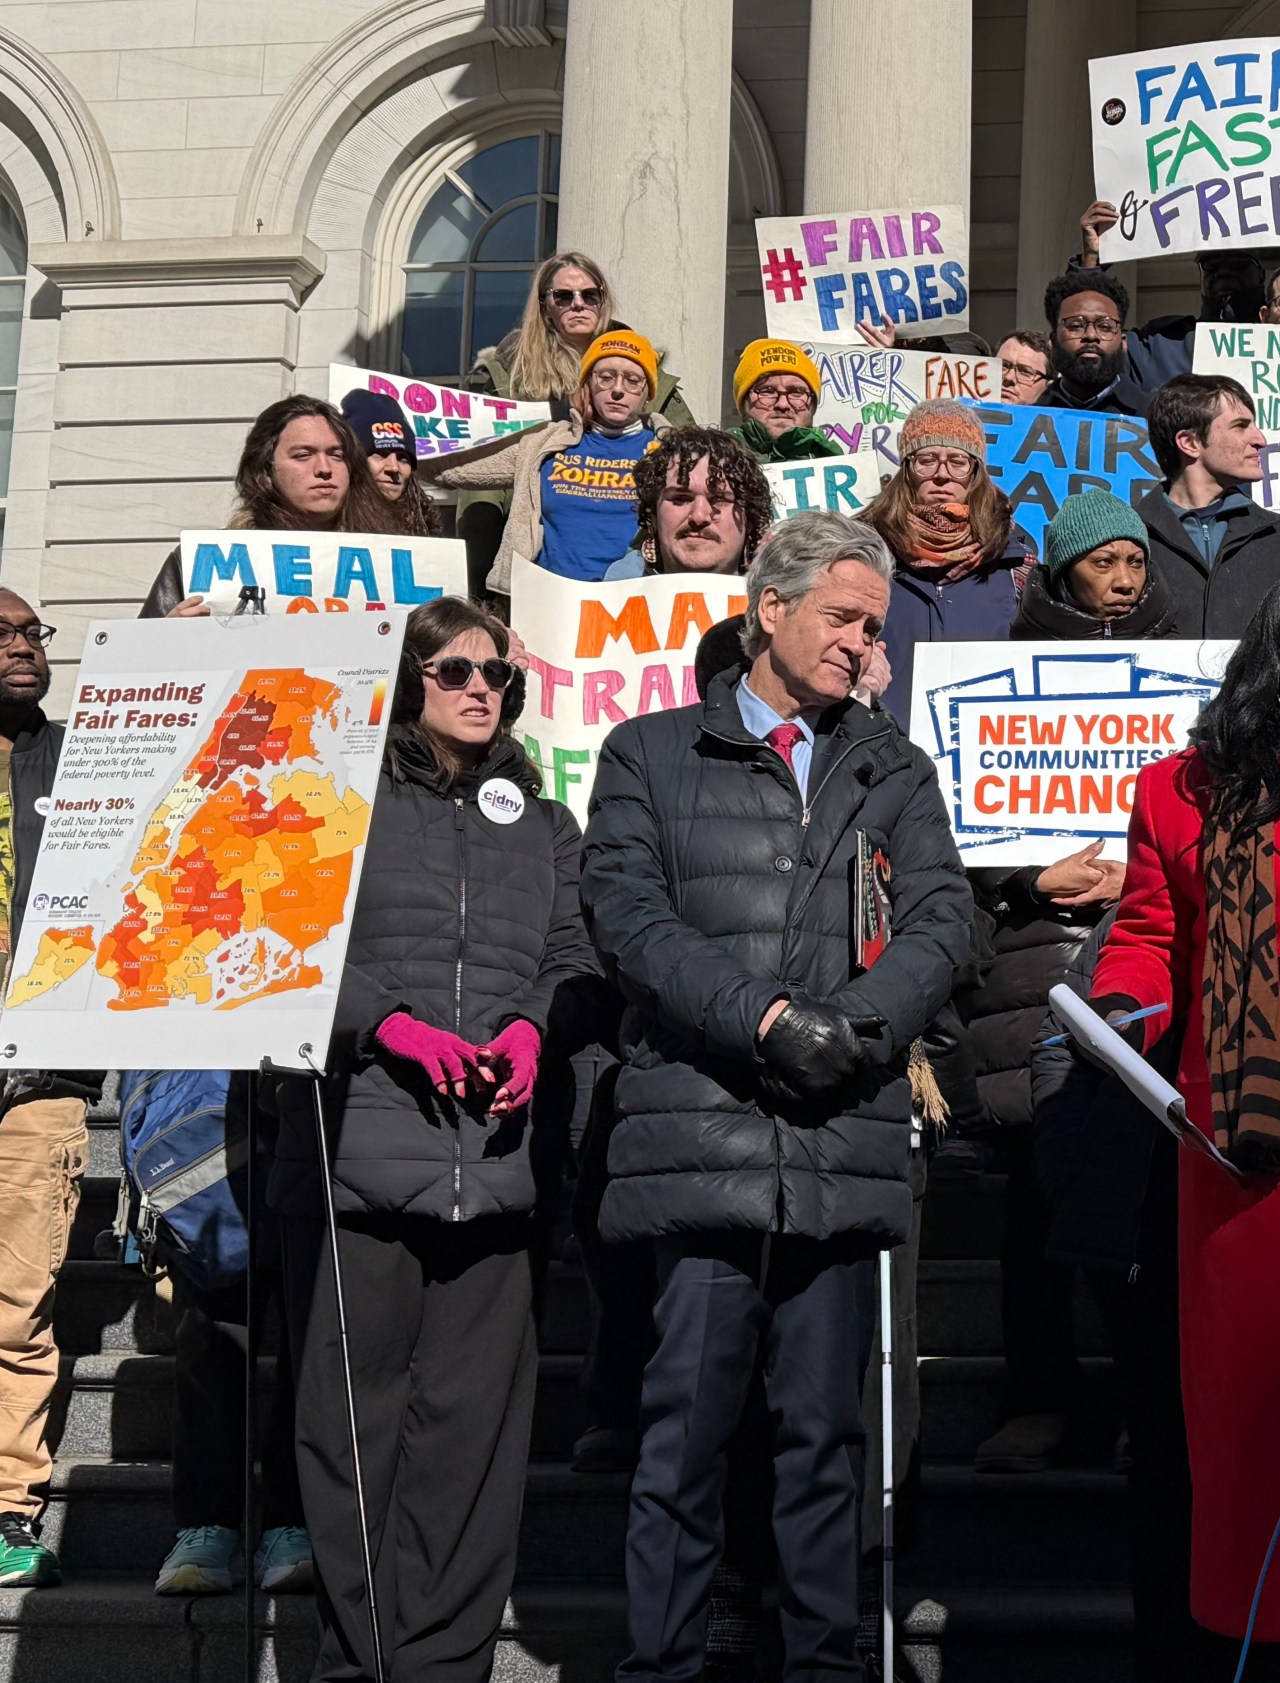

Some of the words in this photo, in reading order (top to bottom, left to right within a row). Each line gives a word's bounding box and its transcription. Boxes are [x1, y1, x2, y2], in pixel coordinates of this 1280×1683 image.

[800, 212, 944, 267] FAIR
[814, 261, 968, 332] FARES
[760, 346, 797, 357] VENDOR
[1209, 328, 1255, 358] WE
[805, 346, 920, 404] AIRER
[925, 355, 991, 400] FARE
[368, 374, 517, 420] DON'T
[861, 402, 908, 425] FOR
[372, 422, 404, 439] CSS
[412, 415, 472, 439] KE
[585, 456, 638, 470] RIDERS
[547, 461, 637, 488] ZOHRA
[772, 464, 864, 514] IR
[189, 543, 444, 604] MEAL
[575, 591, 749, 658] MA
[79, 682, 206, 707] Expanding
[73, 711, 119, 730] Fair
[123, 710, 198, 729] Fares:
[978, 714, 1067, 746] NEW
[1073, 714, 1175, 745] YORK
[69, 735, 117, 745] Deepening
[118, 733, 177, 744] affordability
[64, 746, 80, 757] for
[81, 747, 103, 756] New
[105, 746, 140, 755] Yorkers
[141, 745, 177, 755] making
[979, 749, 1164, 770] COMMUNITIES
[64, 758, 91, 768] under
[91, 758, 119, 769] 300%
[120, 757, 133, 768] of
[132, 757, 146, 766] the
[59, 769, 92, 781] federal
[94, 770, 130, 780] poverty
[131, 768, 155, 778] level.
[54, 798, 102, 812] Nearly
[105, 797, 135, 810] 30%
[50, 817, 62, 827] of
[61, 817, 73, 826] all
[74, 817, 97, 826] New
[99, 816, 134, 825] Yorkers
[48, 828, 76, 838] would
[78, 827, 90, 837] be
[91, 826, 124, 839] eligible
[42, 840, 59, 852] for
[61, 841, 80, 850] Fair
[82, 840, 111, 850] Fares.
[49, 895, 88, 909] PCAC
